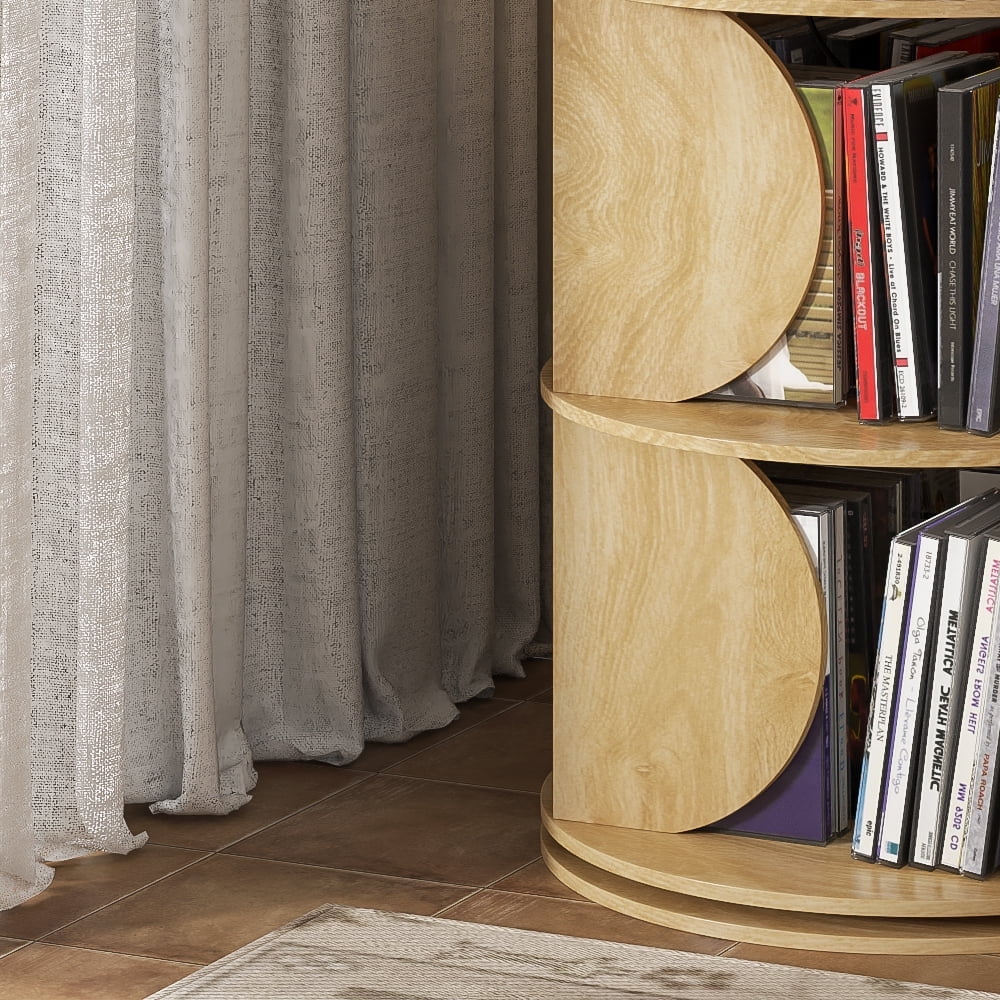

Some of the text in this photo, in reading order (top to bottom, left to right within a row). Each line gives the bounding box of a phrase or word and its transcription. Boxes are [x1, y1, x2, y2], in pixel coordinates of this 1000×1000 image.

[878, 147, 887, 181] HOWARD
[883, 208, 891, 230] WHITE
[890, 281, 896, 289] at
[990, 280, 1000, 306] MUJER
[855, 272, 868, 331] BLACKOUT
[891, 292, 899, 316] Chard
[893, 319, 900, 329] On
[923, 551, 932, 580] 18733-2
[911, 616, 926, 645] Olga
[876, 655, 893, 742] THE MASTERPLAN
[991, 674, 1000, 703] MURDER
[891, 748, 909, 795] Contigo
[981, 753, 990, 777] PAPA
[977, 779, 986, 810] ROACH
[865, 820, 874, 837] epic
